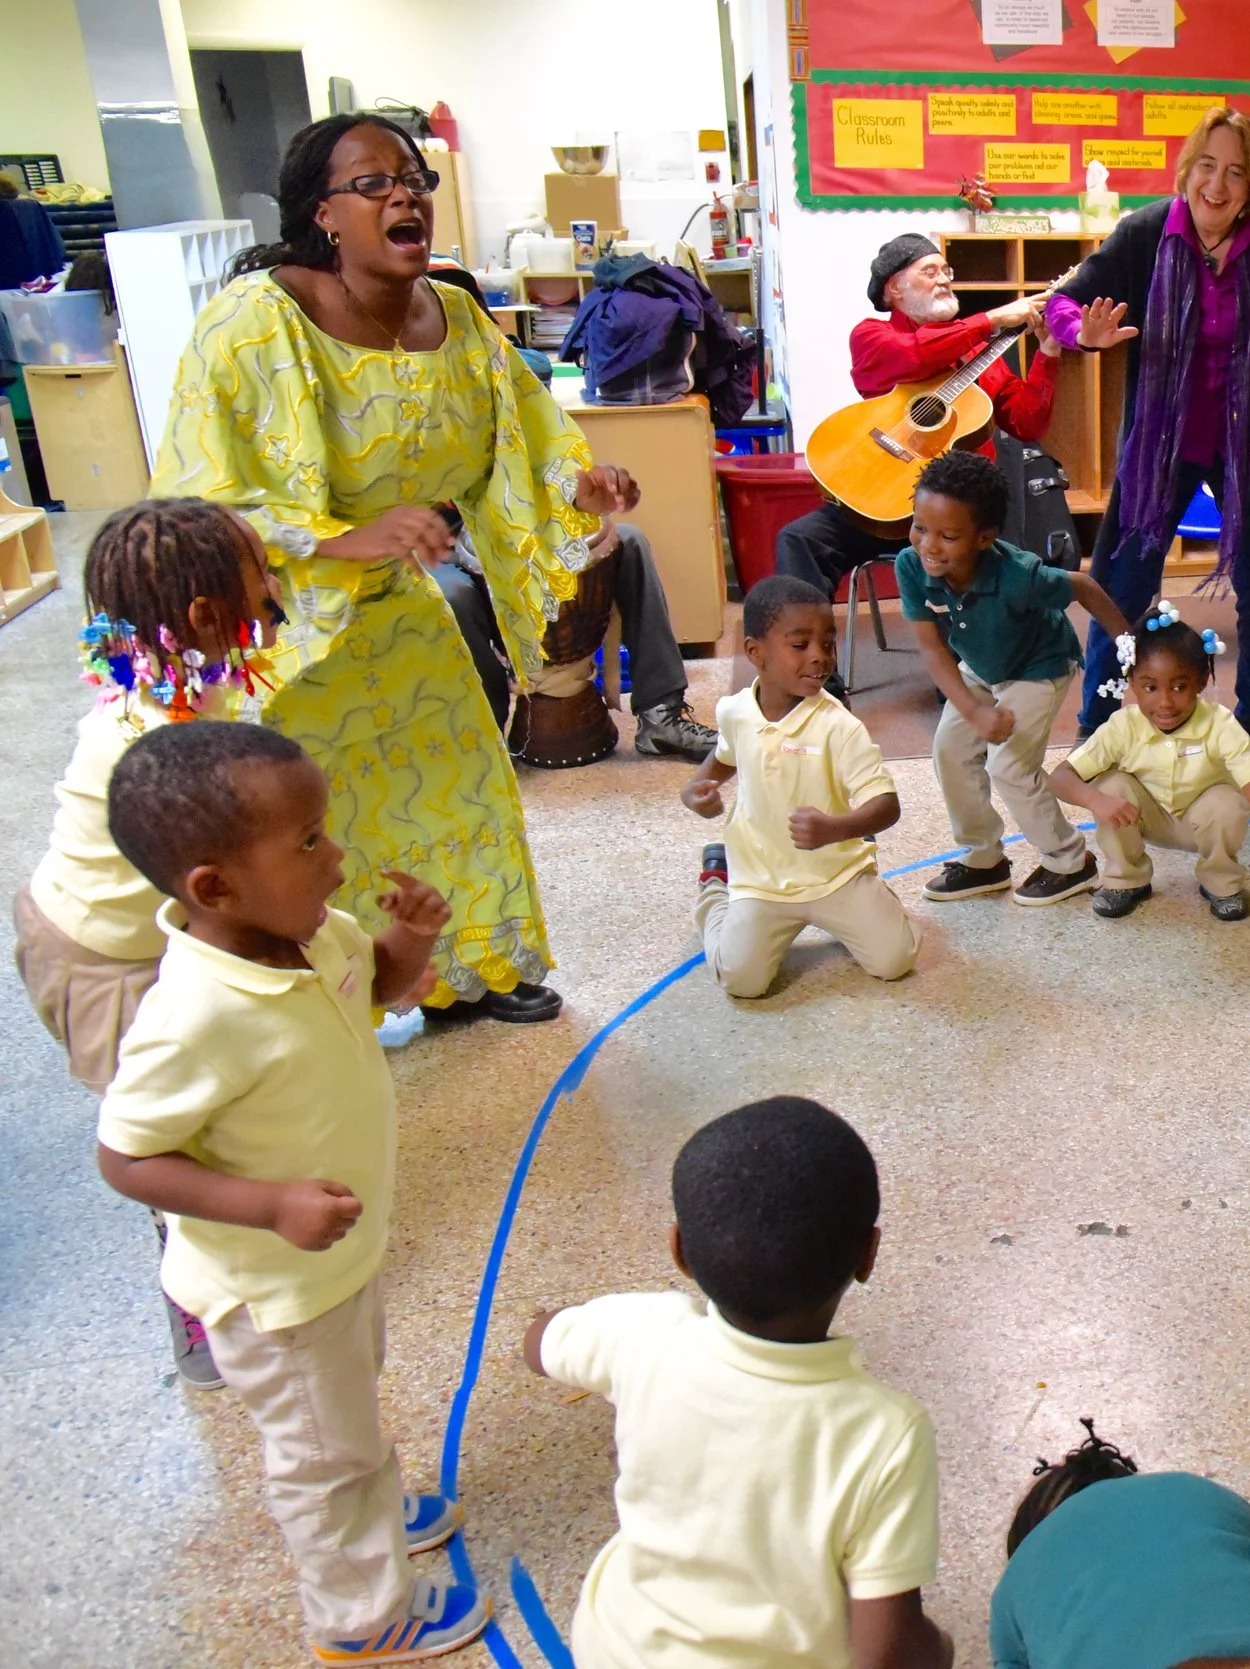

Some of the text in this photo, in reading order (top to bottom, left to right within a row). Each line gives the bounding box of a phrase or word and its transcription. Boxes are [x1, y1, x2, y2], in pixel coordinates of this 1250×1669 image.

[931, 95, 954, 109] Speak
[955, 99, 978, 109] quietly
[1001, 100, 1014, 108] and
[1034, 98, 1049, 110] Help
[1063, 99, 1087, 109] another
[1145, 97, 1166, 109] Follow
[1167, 99, 1176, 110] all
[837, 104, 906, 127] Classroom
[932, 107, 966, 119] positively
[976, 109, 997, 117] adults
[998, 109, 1011, 117] and
[1084, 111, 1097, 119] and
[856, 127, 893, 145] Rules
[987, 148, 1001, 159] Use
[1017, 150, 1039, 160] words
[1041, 150, 1048, 160] to
[1084, 144, 1104, 156] Show
[1106, 146, 1130, 157] respect
[1131, 147, 1140, 156] for
[1003, 162, 1034, 171] problems
[1035, 162, 1045, 170] not
[988, 170, 1012, 180] hands
